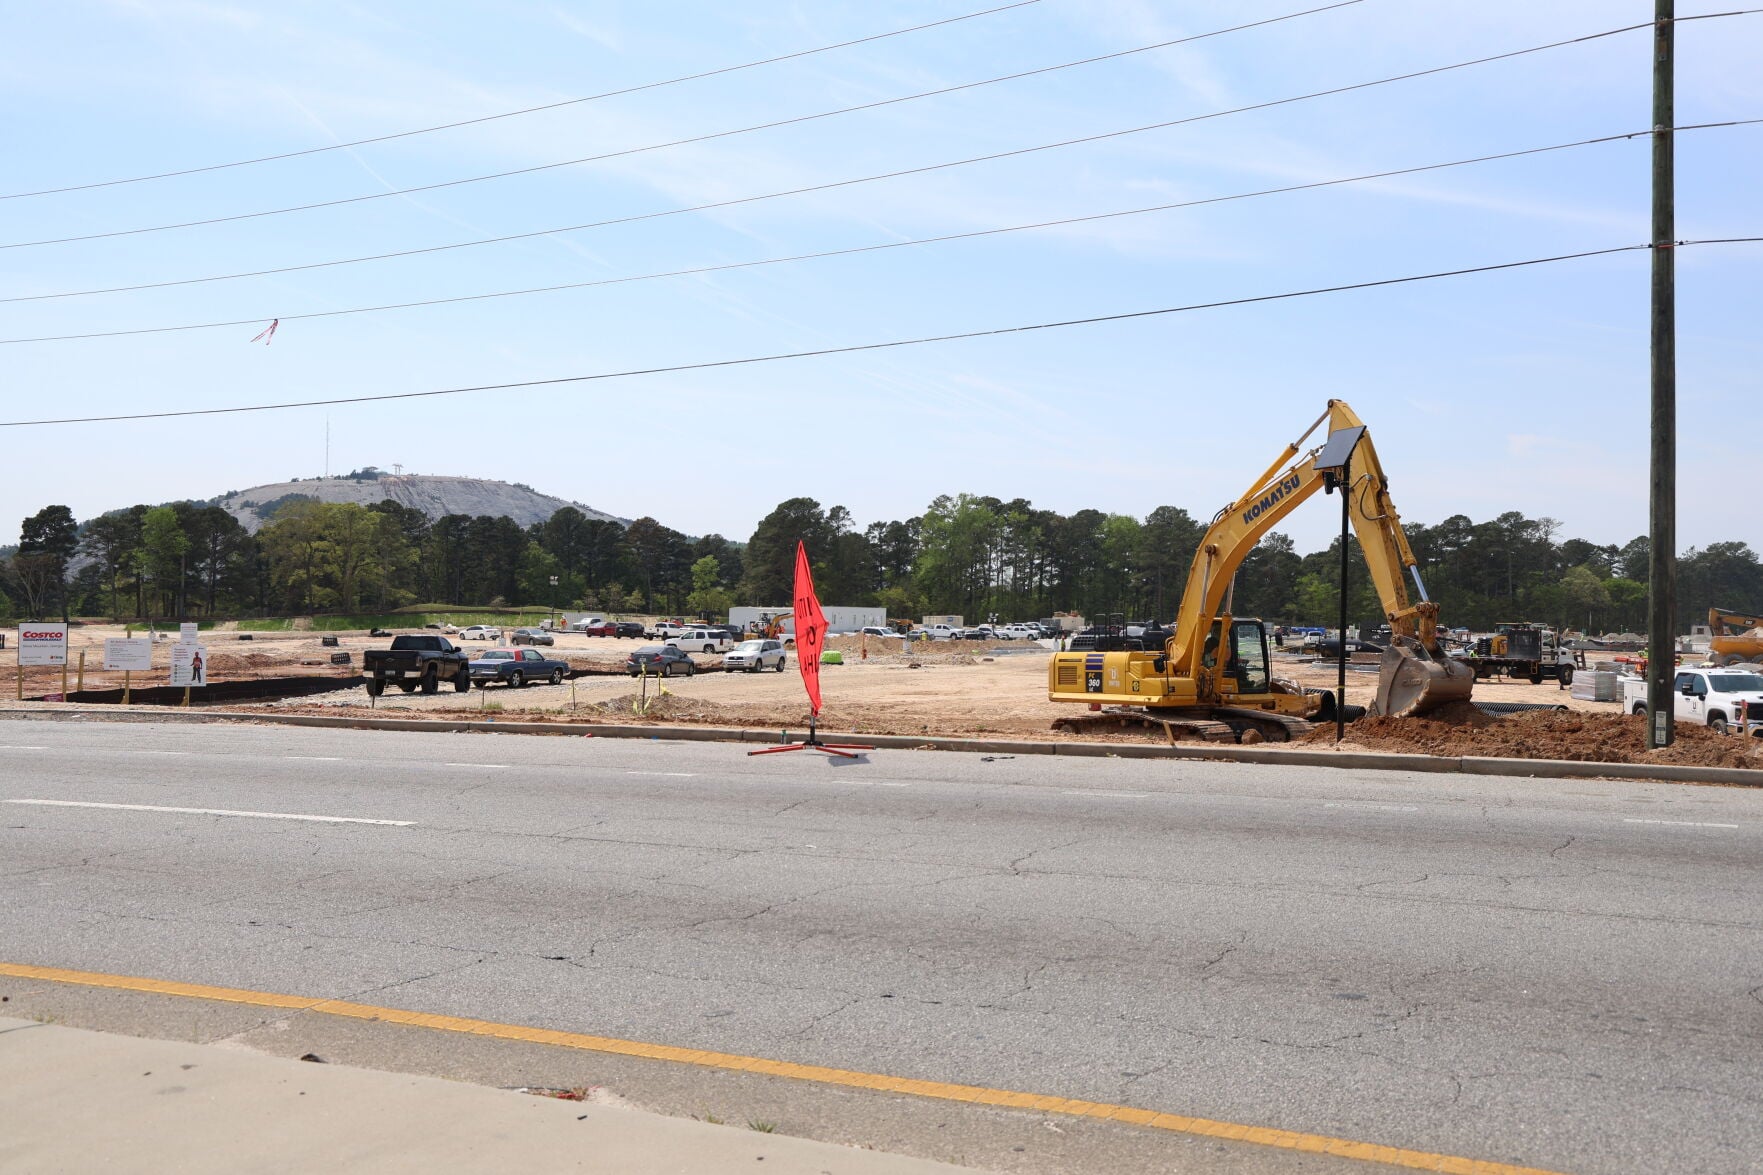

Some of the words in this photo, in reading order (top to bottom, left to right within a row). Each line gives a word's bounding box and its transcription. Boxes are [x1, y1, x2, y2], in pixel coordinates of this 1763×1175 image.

[1243, 474, 1300, 525] KOMATSU
[23, 631, 63, 639] COSTCO
[1088, 679, 1100, 687] 360
